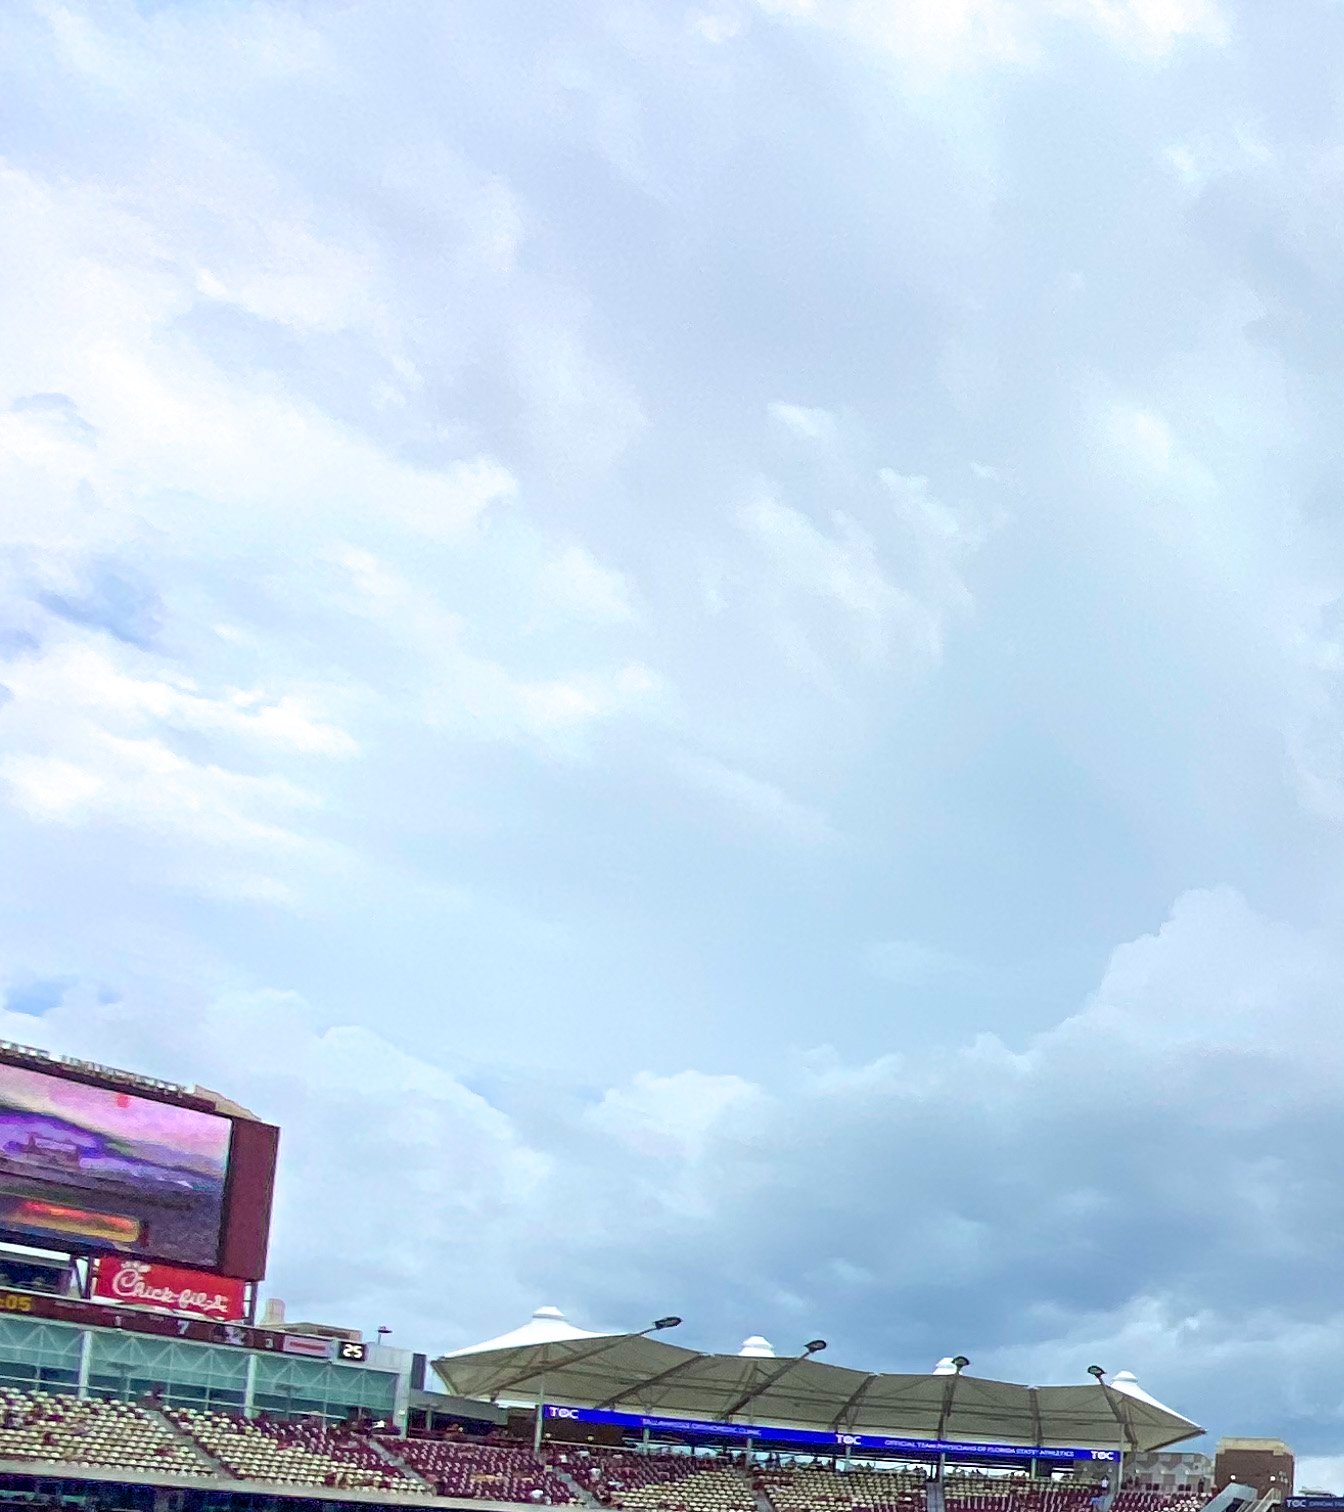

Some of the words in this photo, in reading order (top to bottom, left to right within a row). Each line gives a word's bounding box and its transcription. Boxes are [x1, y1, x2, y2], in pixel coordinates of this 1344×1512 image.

[342, 1343, 364, 1358] 25
[550, 1406, 579, 1420] TOC
[836, 1434, 861, 1446] TOC
[1091, 1451, 1114, 1461] TOC
